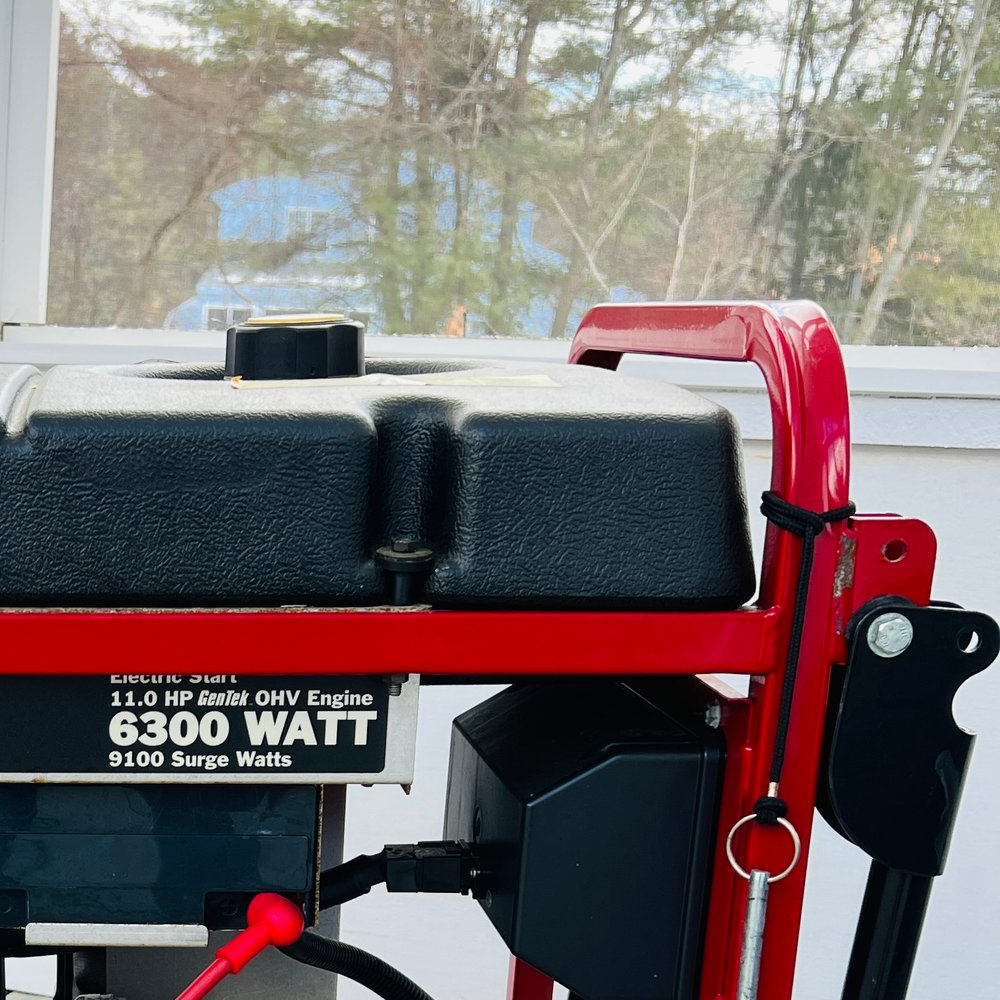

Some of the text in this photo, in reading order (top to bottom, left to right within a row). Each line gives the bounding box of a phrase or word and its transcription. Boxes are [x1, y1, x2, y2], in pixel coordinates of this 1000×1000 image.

[111, 691, 157, 706] 11.0
[165, 691, 194, 706] HP
[255, 690, 300, 706] OHV
[307, 690, 373, 708] Engine
[108, 711, 378, 747] 6300 WATT
[109, 751, 292, 770] 9100 Surge Watts
